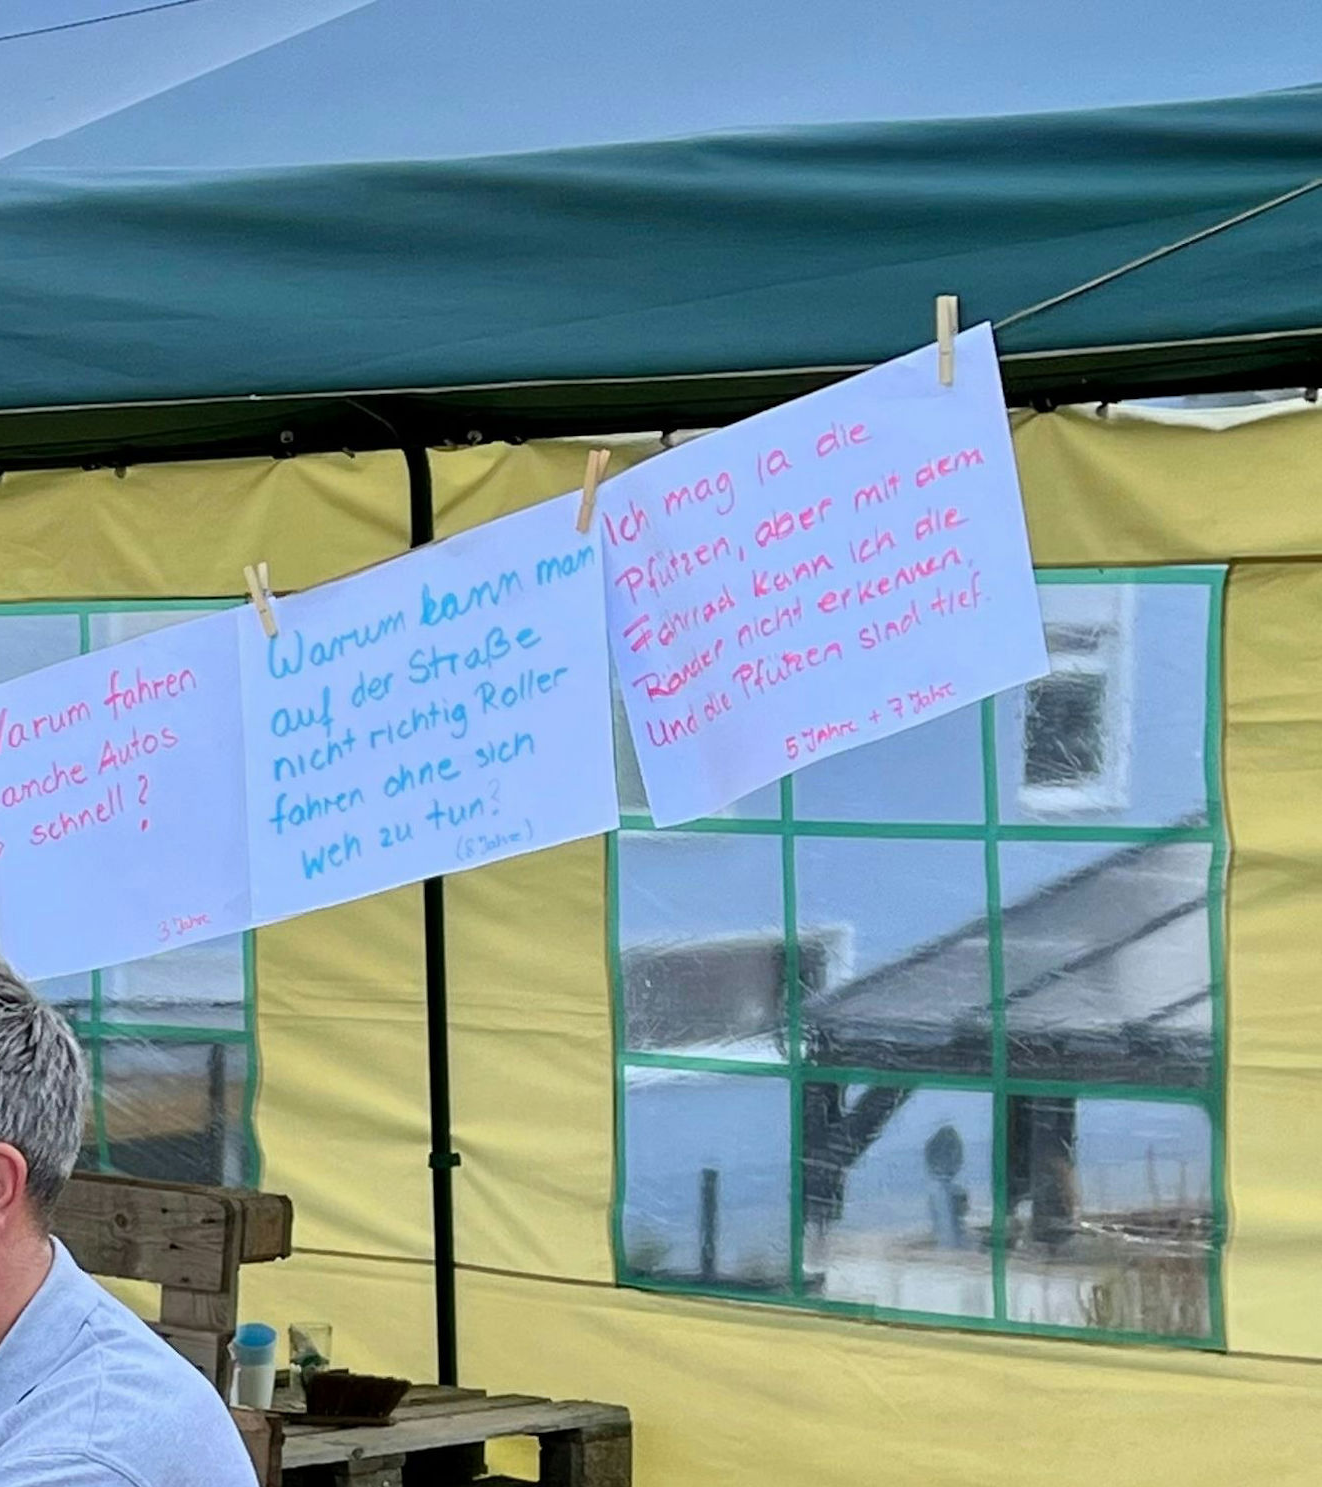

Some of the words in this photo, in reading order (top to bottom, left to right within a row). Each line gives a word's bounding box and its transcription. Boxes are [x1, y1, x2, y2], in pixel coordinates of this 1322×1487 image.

[602, 500, 649, 546] Ich
[663, 472, 735, 515] mag
[816, 421, 873, 458] die
[615, 535, 744, 603] Pfützen,
[755, 497, 832, 547] aber
[854, 470, 900, 512] mit
[915, 447, 985, 488] dem
[268, 610, 405, 679] Warum
[420, 570, 523, 626] kann
[536, 545, 594, 586] man
[623, 584, 735, 653] Fahrrad
[752, 553, 834, 599] kann
[850, 527, 896, 564] ich
[915, 507, 969, 540] die
[737, 594, 803, 648] nicht
[104, 667, 197, 720] fahren
[271, 686, 334, 737] auf
[351, 671, 395, 709] der
[409, 626, 542, 685] Straße
[274, 728, 357, 781] nicht
[369, 702, 467, 748] richtig
[475, 666, 569, 714] Roller
[646, 713, 699, 747] Und
[704, 690, 732, 722] die
[732, 641, 842, 697] Pfützen
[859, 601, 921, 649] sind
[785, 735, 798, 759] 5
[802, 721, 859, 751] Jahre
[868, 709, 882, 724] +
[888, 697, 903, 719] 7
[907, 683, 956, 715] Jahre
[98, 726, 179, 775] Autos
[269, 787, 364, 835] fahren
[384, 758, 461, 798] ohne
[477, 731, 535, 769] sich
[302, 835, 361, 879] weh
[380, 823, 413, 849] zu
[426, 778, 502, 830] tun?
[158, 921, 170, 942] 3
[172, 913, 212, 935] Jahre
